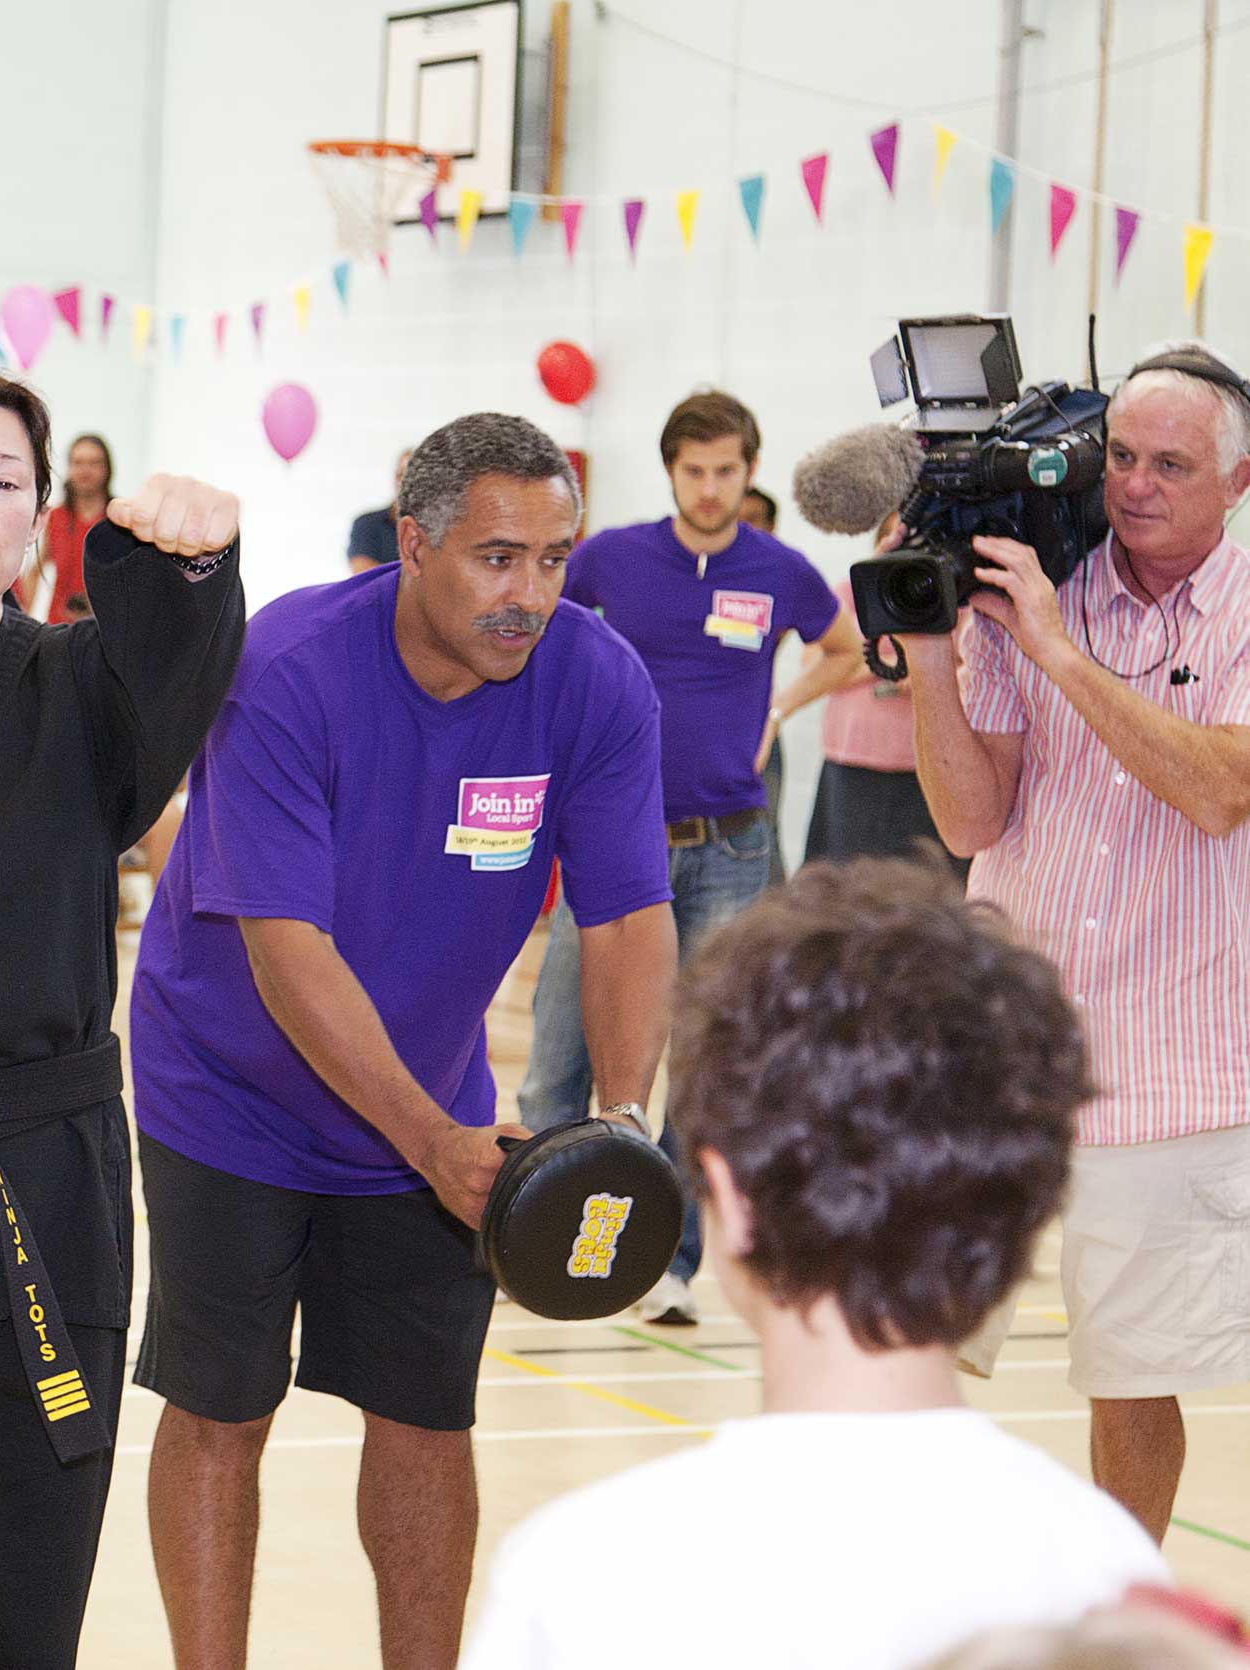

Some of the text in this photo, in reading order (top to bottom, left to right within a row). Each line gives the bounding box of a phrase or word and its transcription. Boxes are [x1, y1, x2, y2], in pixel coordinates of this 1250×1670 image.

[468, 793, 512, 816] Join
[486, 813, 534, 825] Local Sport
[24, 1284, 57, 1362] TOTS
